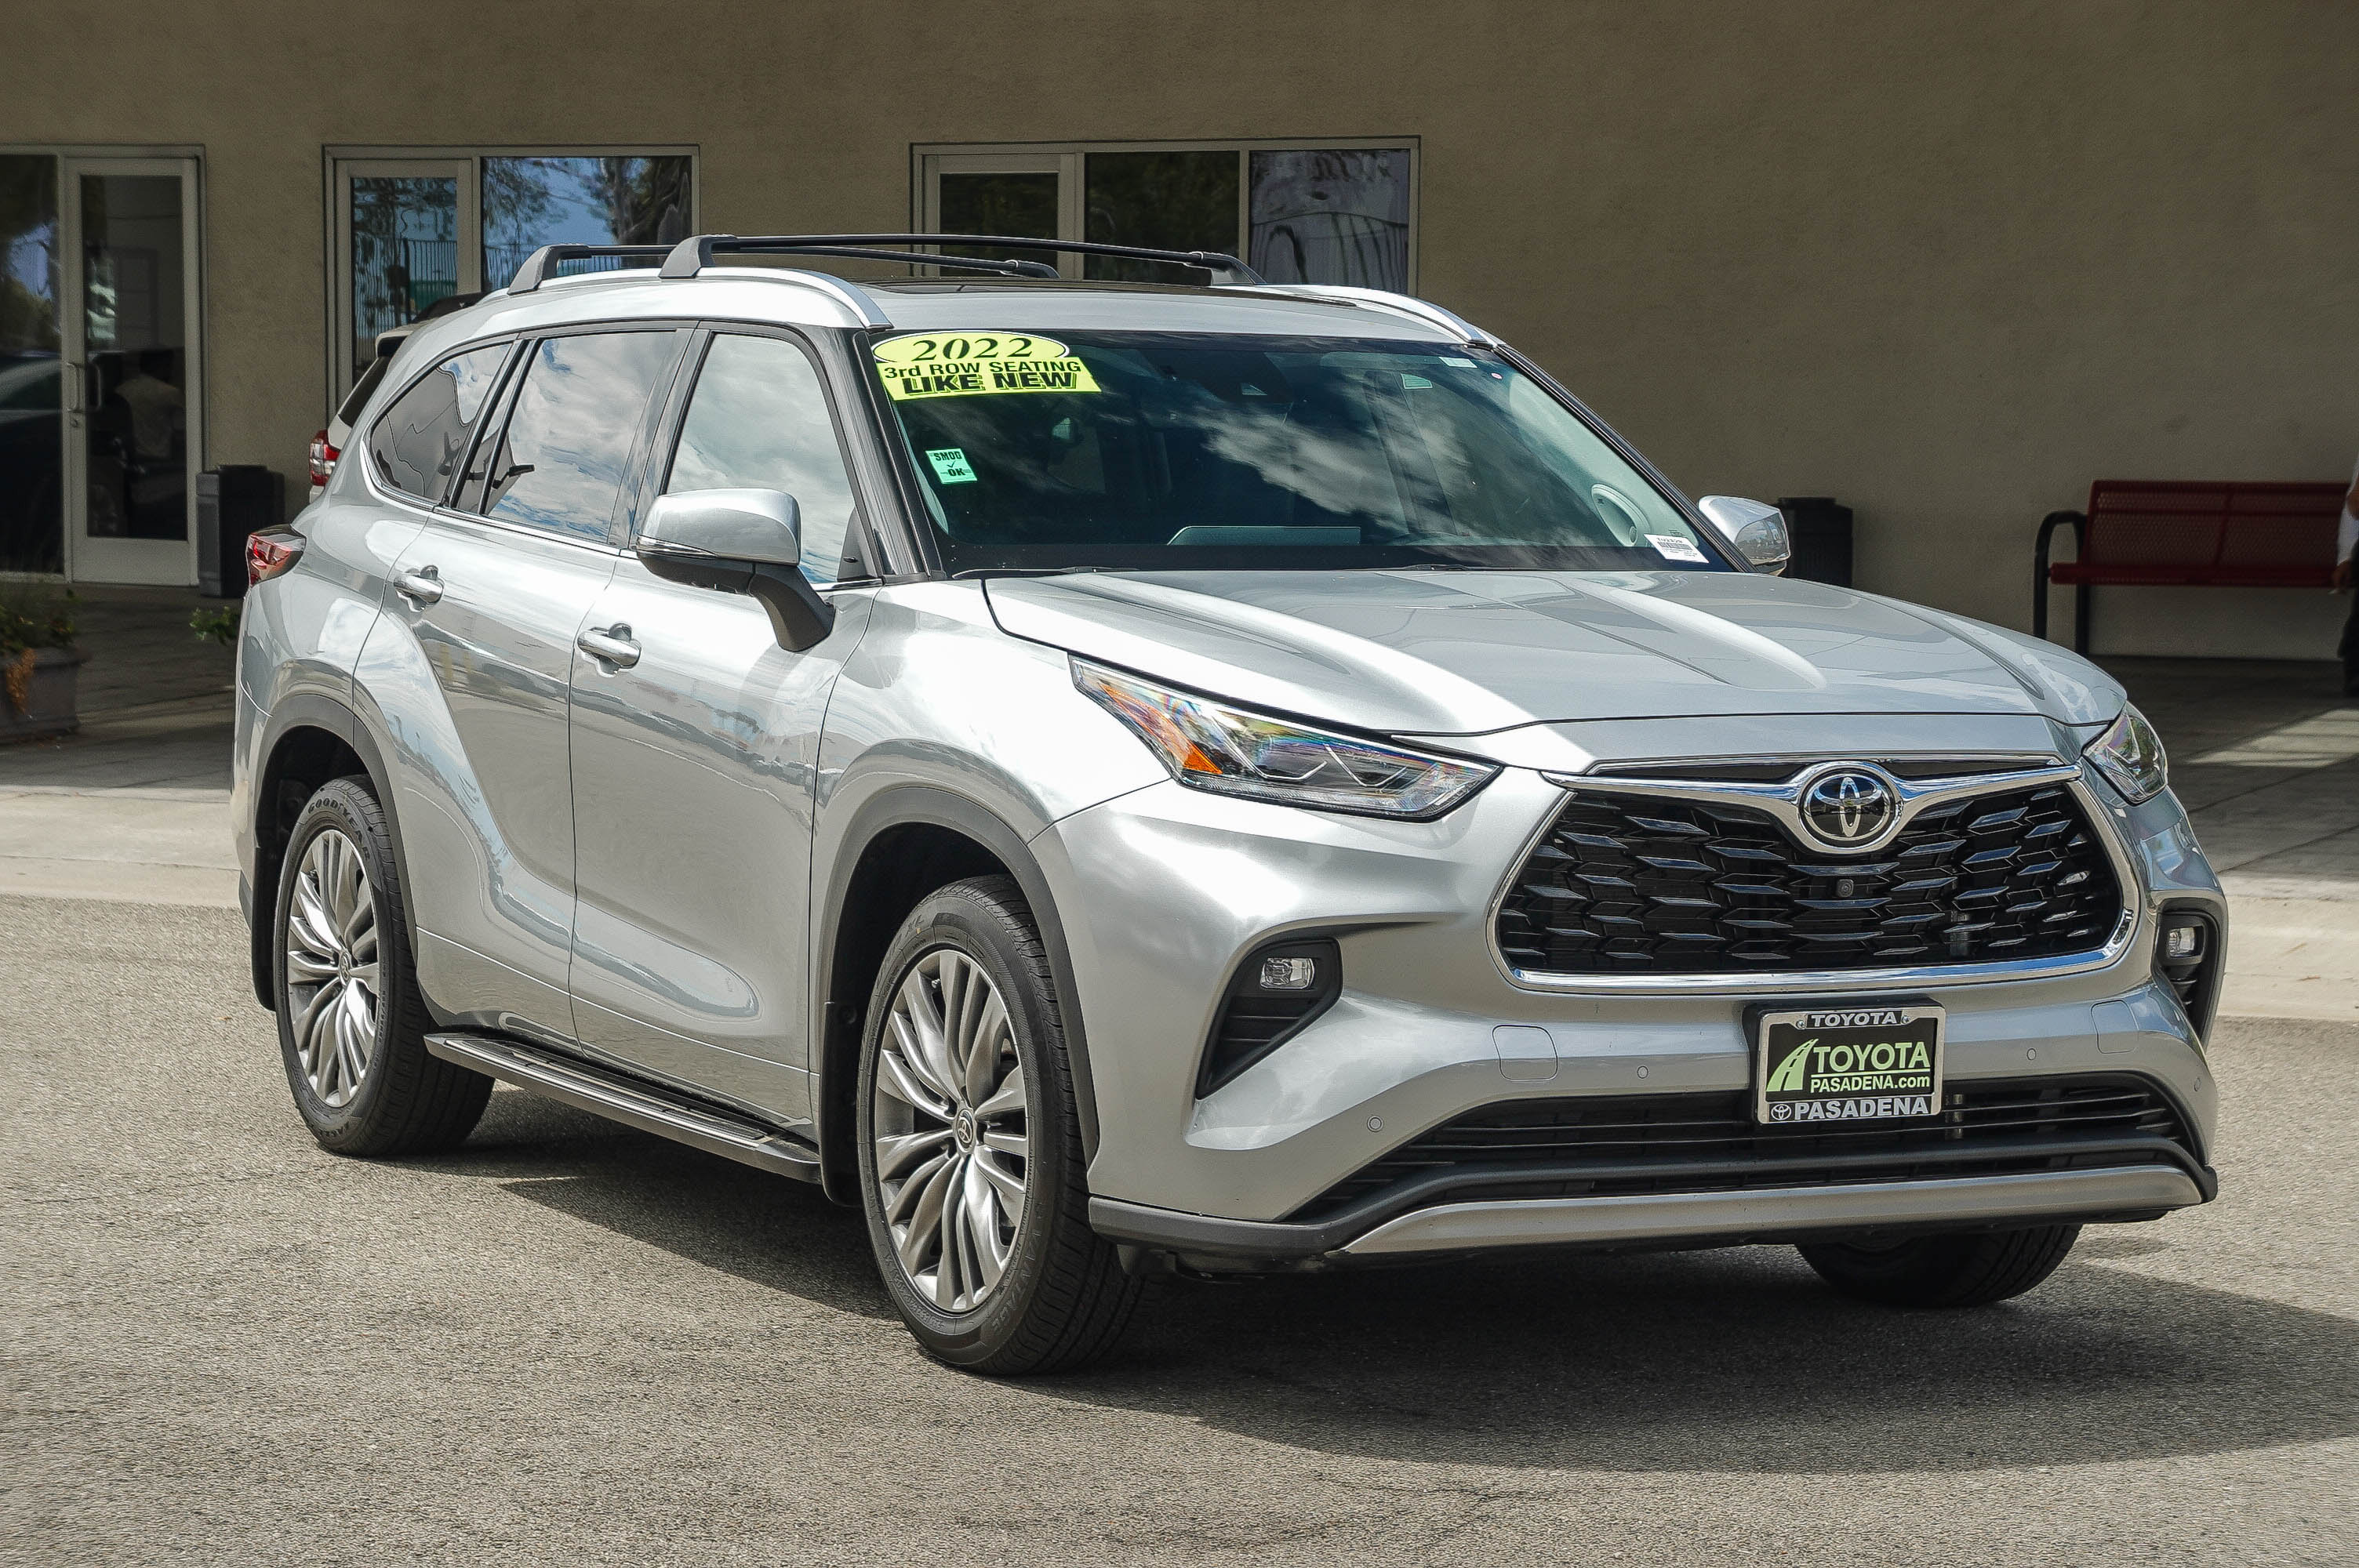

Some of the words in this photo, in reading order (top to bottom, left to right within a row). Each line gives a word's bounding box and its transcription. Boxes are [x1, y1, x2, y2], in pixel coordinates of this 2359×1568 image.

[911, 337, 1033, 361] 2022
[884, 365, 922, 379] 3rd
[929, 362, 980, 375] ROW
[988, 361, 1081, 372] SEATING
[901, 373, 984, 395] LIKE
[993, 372, 1077, 390] NEW
[933, 451, 962, 462] SMOG
[947, 467, 966, 477] OK
[1811, 1011, 1898, 1027] TOYOTA
[1812, 1041, 1931, 1073] TOYOTA
[1810, 1075, 1930, 1094] PASADENA.com
[1794, 1097, 1928, 1120] PASADENA
